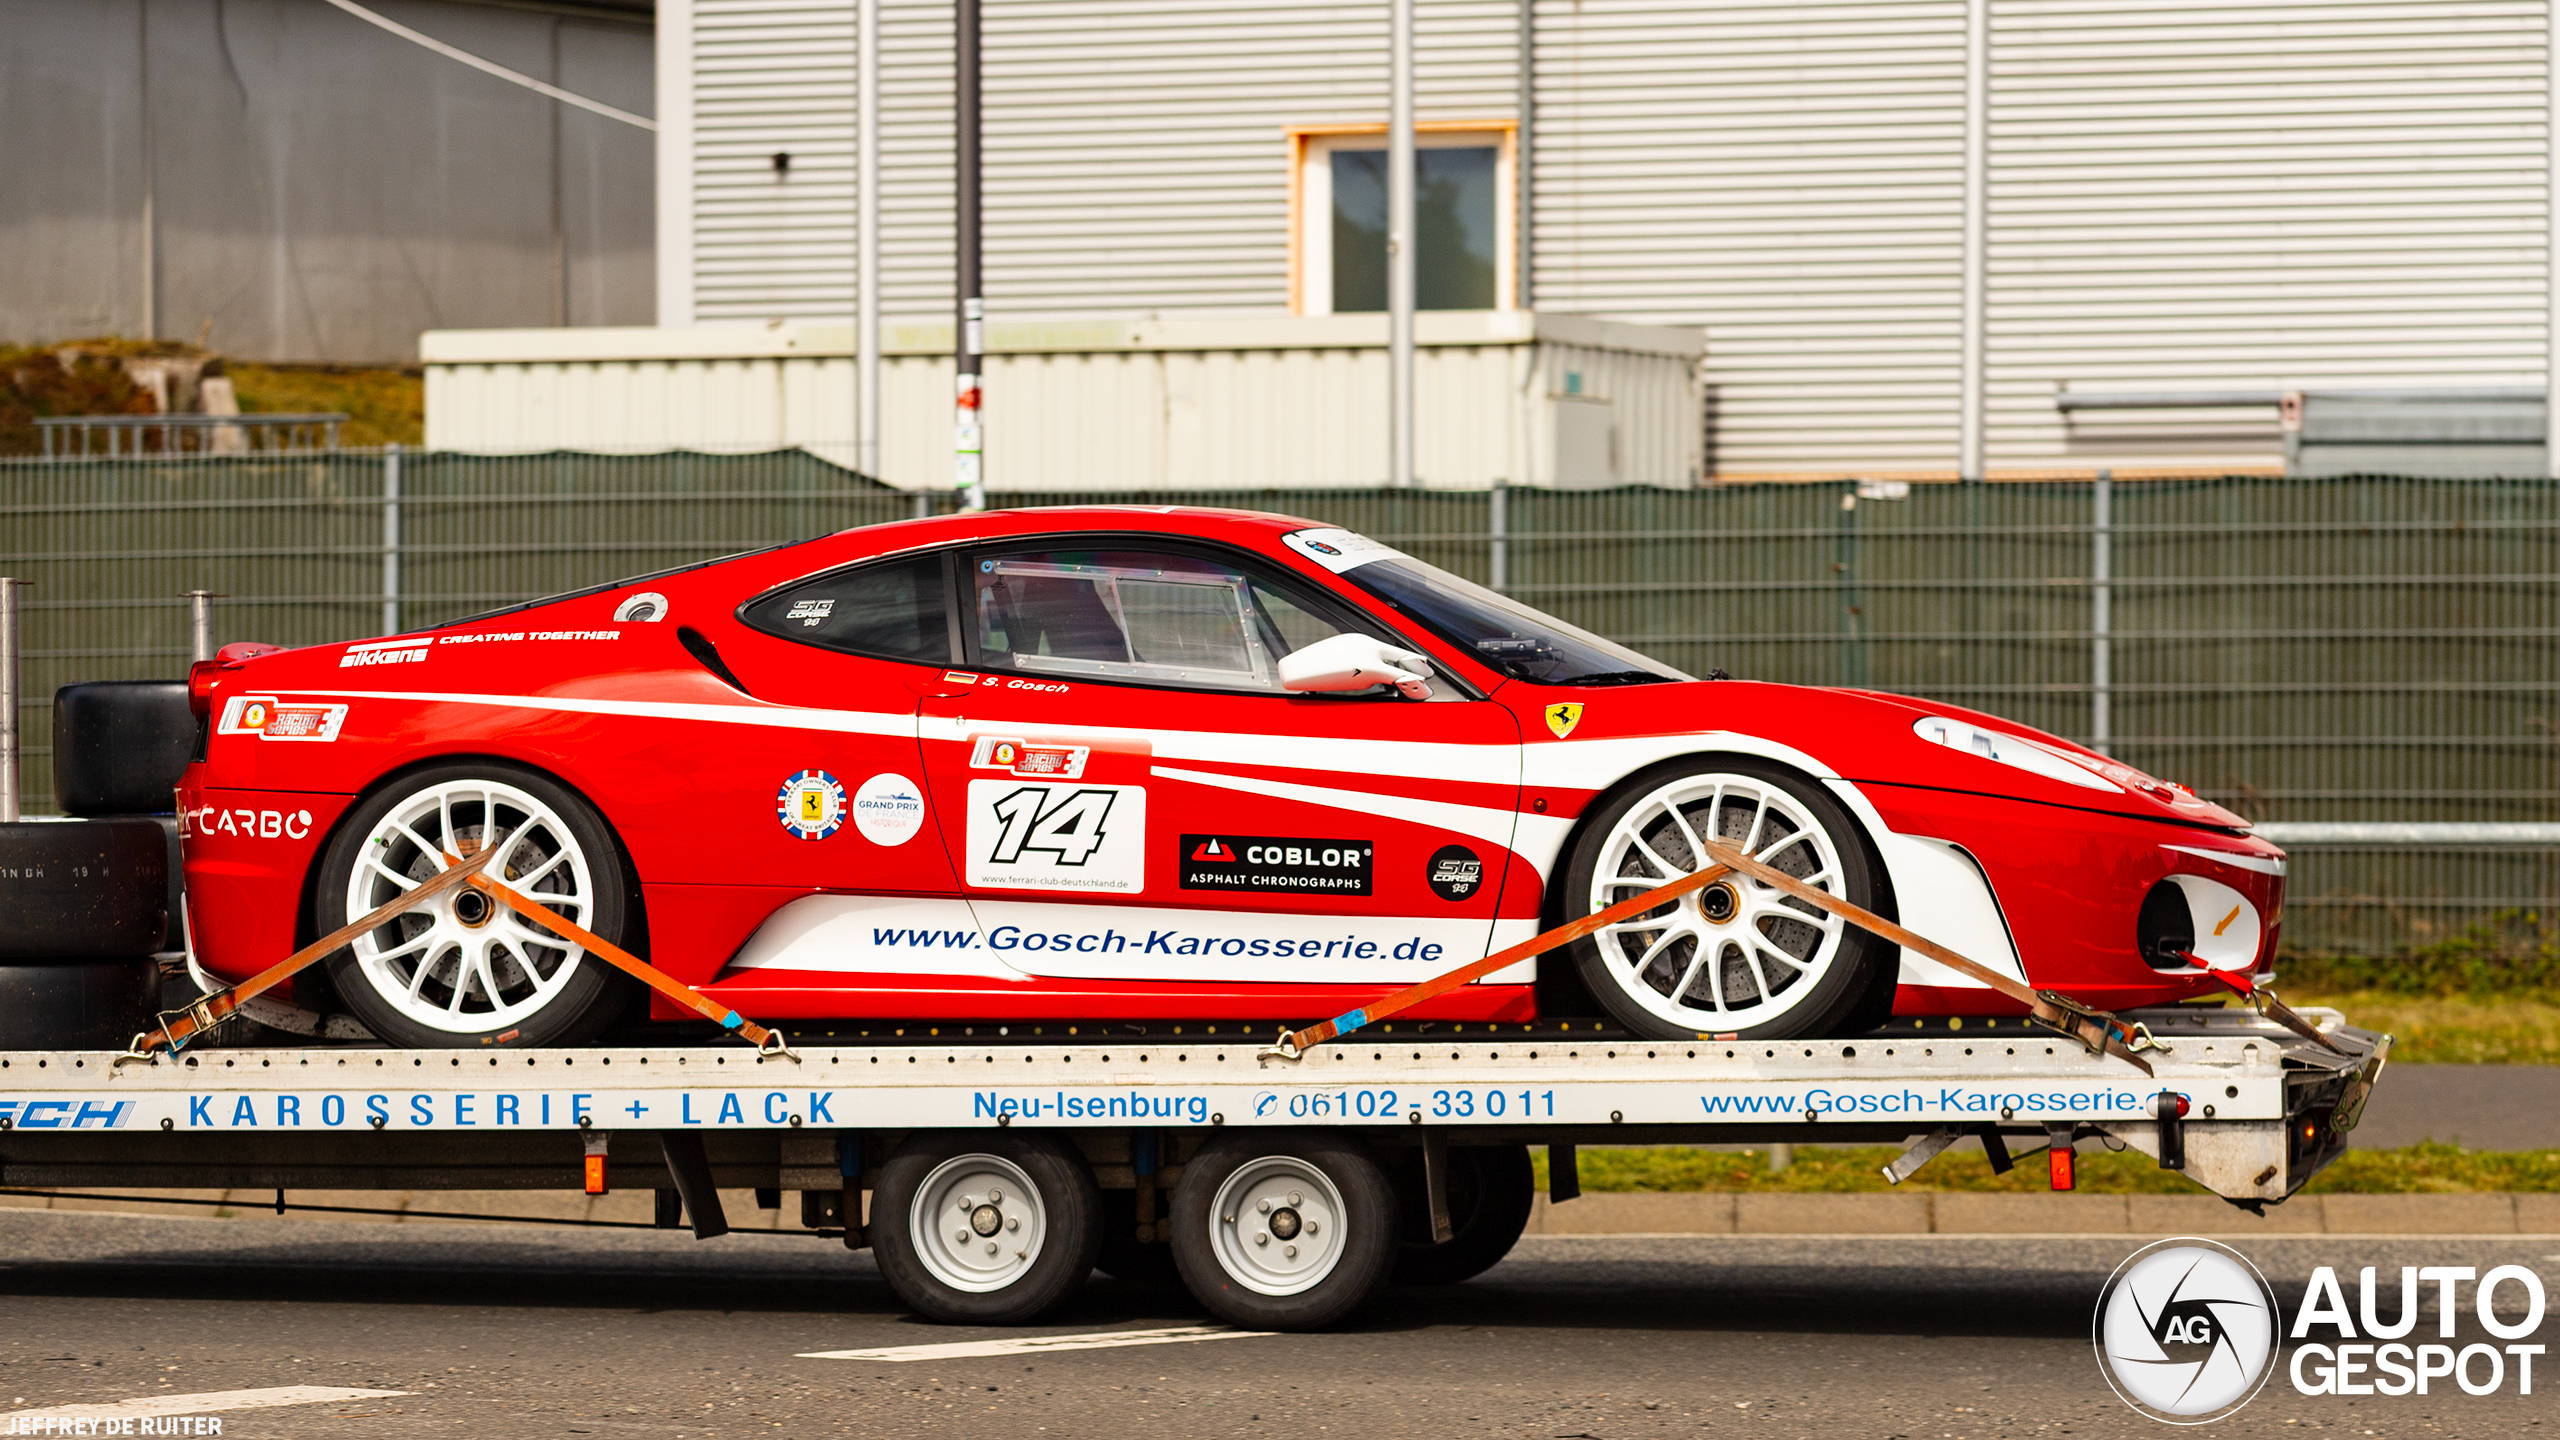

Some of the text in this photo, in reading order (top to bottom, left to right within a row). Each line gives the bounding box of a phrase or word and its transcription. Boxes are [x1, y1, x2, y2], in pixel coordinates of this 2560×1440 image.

[791, 599, 835, 612] SG
[786, 610, 831, 619] CORSE
[439, 631, 620, 645] CREATING TOGETHER
[982, 677, 1070, 693] S. Gosch
[267, 722, 308, 736] Series
[276, 713, 321, 730] Racing
[1017, 761, 1055, 773] Series
[1025, 753, 1066, 768] Racing
[858, 800, 919, 811] GRAND PRIX
[794, 820, 813, 830] GREAT
[814, 813, 835, 830] BRITAIN
[857, 808, 919, 820] DE FRANCE
[200, 808, 312, 840] CARBO
[989, 787, 1119, 866] 14
[1437, 859, 1481, 875] SG
[981, 875, 1128, 889] www.ferrari-club-deutschland.de
[1190, 873, 1361, 889] ASPHALT CHRONOGRAPHS
[1433, 874, 1479, 883] CORSE
[872, 925, 1444, 962] www.Gosch-Karosserie.de
[974, 1091, 1208, 1123] Neu-Isenburg
[1700, 1087, 2192, 1113] www.Gosch-Karosserie.
[189, 1094, 592, 1127] KAROSSERIE
[625, 1099, 649, 1119] +
[682, 1092, 835, 1125] LACK
